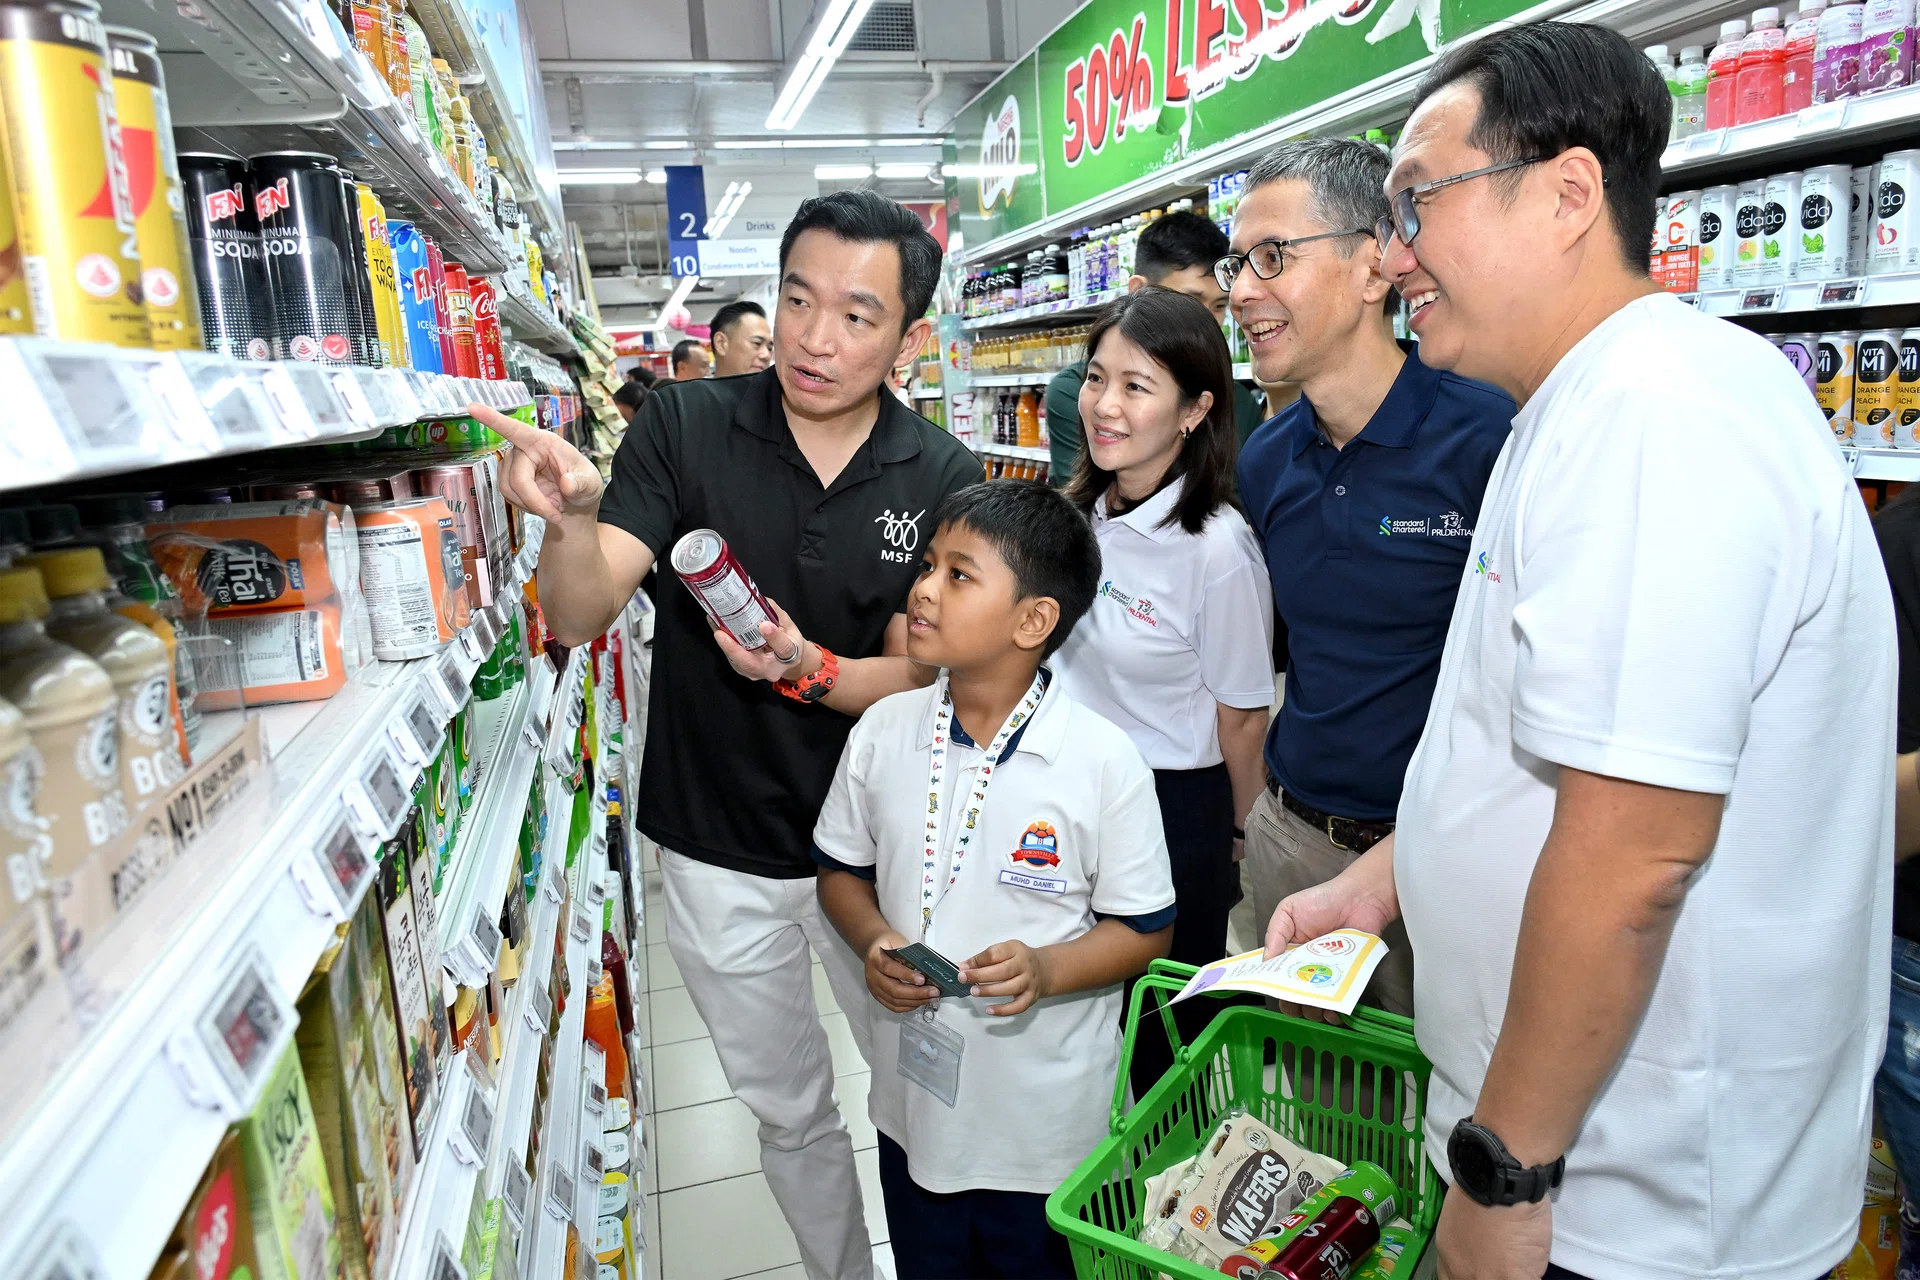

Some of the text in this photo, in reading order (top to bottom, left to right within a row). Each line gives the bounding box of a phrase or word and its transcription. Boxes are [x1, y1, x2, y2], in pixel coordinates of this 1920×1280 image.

[1063, 16, 1153, 165] 50%
[206, 183, 244, 222] F&N
[256, 178, 290, 222] F&N
[1880, 191, 1903, 206] ida
[680, 212, 697, 238] 2
[1765, 211, 1784, 226] ida
[746, 221, 776, 232] Drinks
[1701, 220, 1720, 233] ida
[213, 241, 259, 259] SODA
[672, 255, 697, 275] 10
[702, 263, 745, 271] Condiments
[1862, 347, 1885, 357] VITA
[1861, 355, 1885, 371] MI
[1816, 386, 1835, 394] ANGE
[1857, 386, 1891, 394] ORANGE
[1872, 414, 1880, 422] C
[431, 426, 443, 438] up
[880, 550, 912, 564] MSF
[228, 546, 264, 600] Thai
[289, 561, 302, 589] POLAR
[217, 583, 231, 603] Tea
[1108, 591, 1128, 607] chartered
[1111, 587, 1130, 602] standard
[1128, 607, 1157, 628] PRUDENTIAL
[1019, 849, 1055, 859] TOWNSVILLE
[1010, 875, 1055, 889] MUHD DANIEL
[1250, 1132, 1262, 1144] 90
[1221, 1154, 1289, 1245] WAFERS
[1193, 1209, 1206, 1225] LEE
